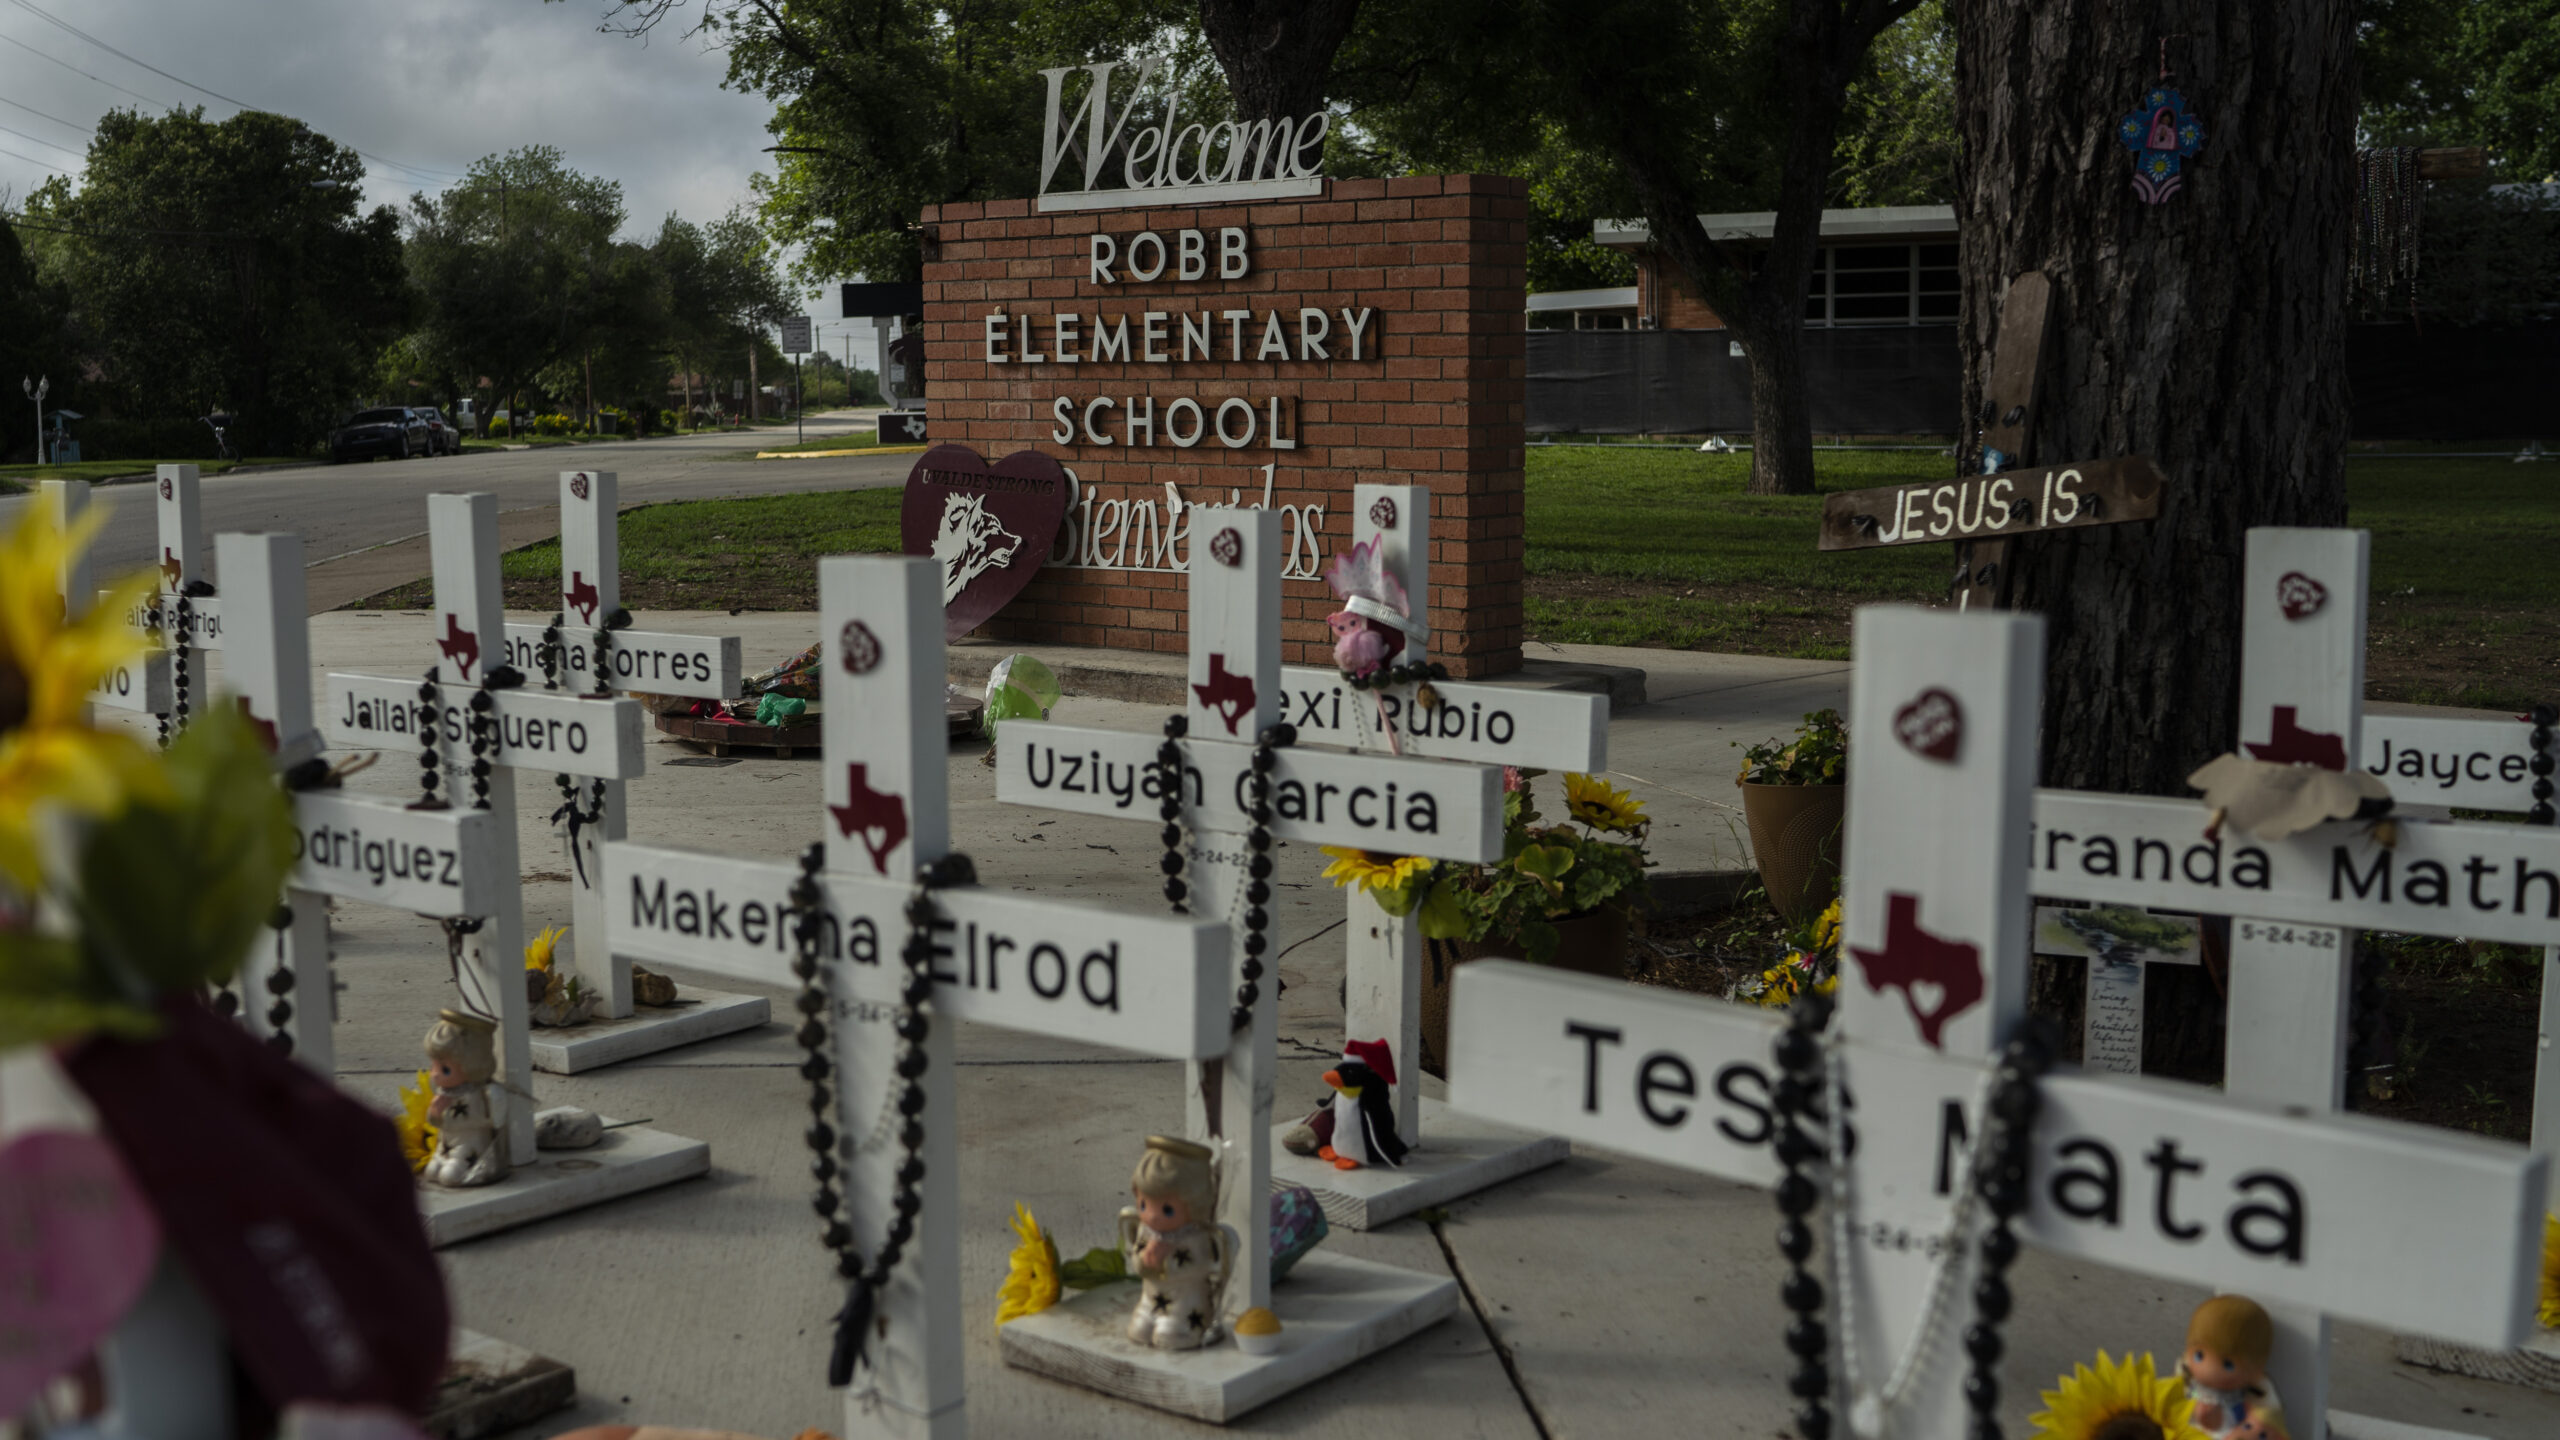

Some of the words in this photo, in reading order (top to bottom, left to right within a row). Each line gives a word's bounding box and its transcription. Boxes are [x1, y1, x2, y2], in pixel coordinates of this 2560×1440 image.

[1037, 57, 1330, 194] Welcome
[1090, 226, 1250, 286] ROBB
[985, 306, 1371, 364] ELEMENTARY
[1052, 395, 1296, 450] SCHOOL
[920, 468, 985, 489] UVALDE
[986, 472, 1056, 497] STRONG
[1877, 478, 2014, 543] JESUS
[2040, 469, 2083, 527] IS
[613, 648, 711, 682] orres
[1375, 694, 1515, 745] Rubio
[2368, 738, 2528, 789] Jayce
[2240, 926, 2337, 950] 5-24-22
[926, 917, 1123, 1015] Elrod
[2090, 1019, 2140, 1035] beautiful
